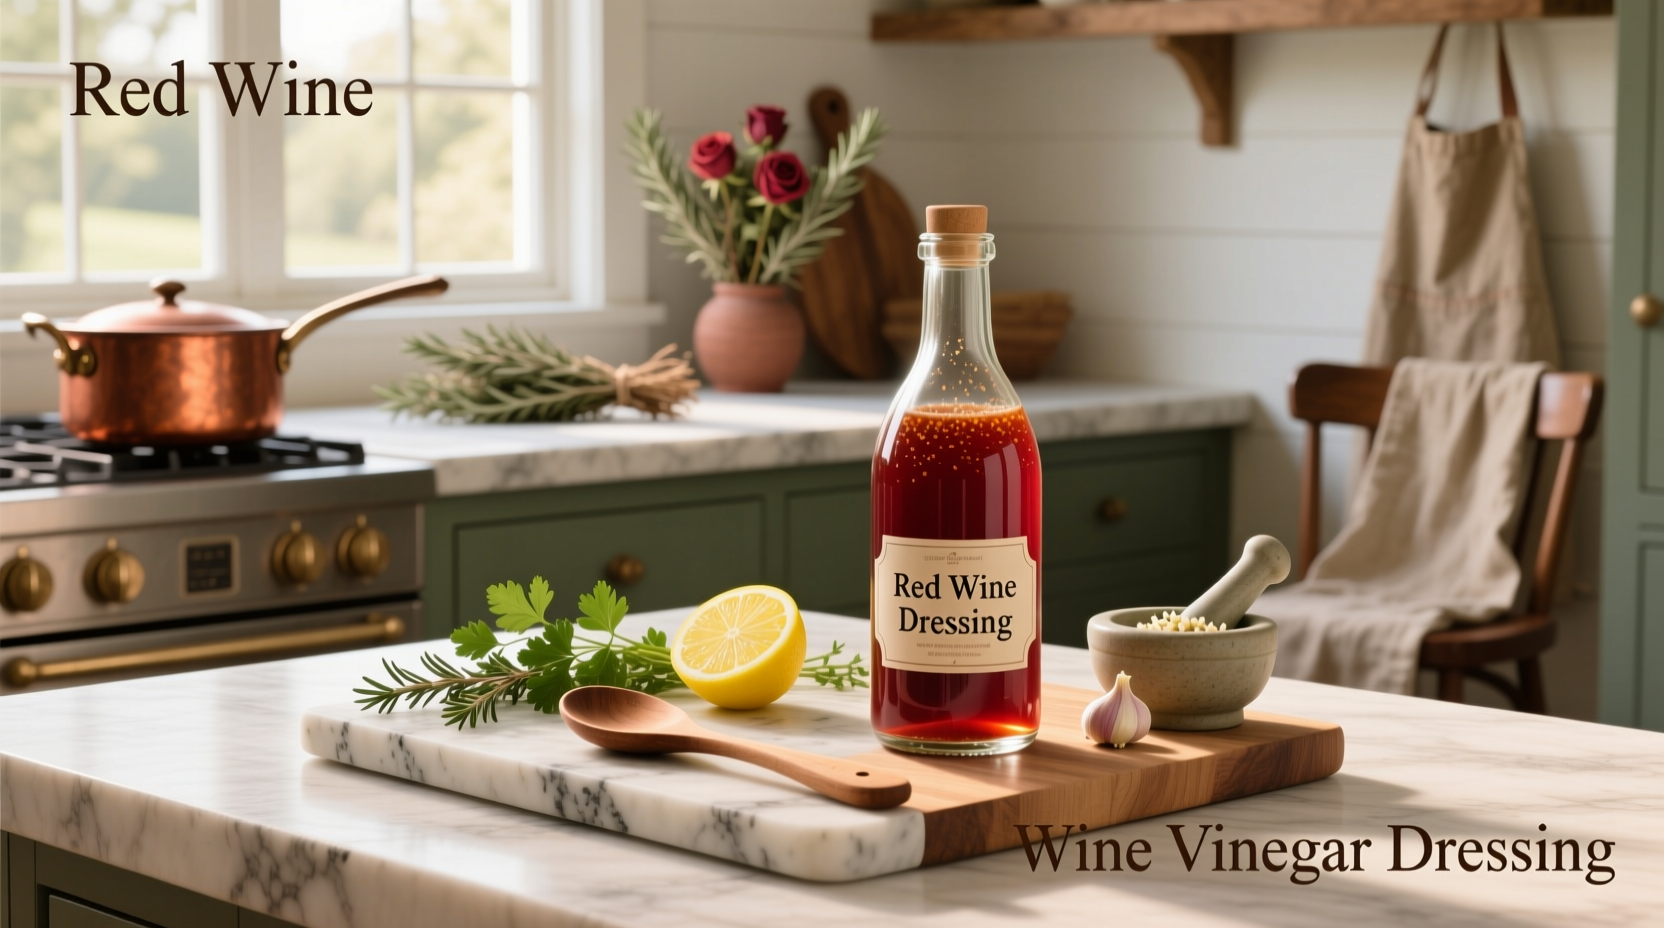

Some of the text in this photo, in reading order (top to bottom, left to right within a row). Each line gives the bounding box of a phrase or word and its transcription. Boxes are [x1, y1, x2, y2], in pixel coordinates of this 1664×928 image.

[893, 573, 1016, 600] Red Wine
[899, 607, 1012, 641] Dressing
